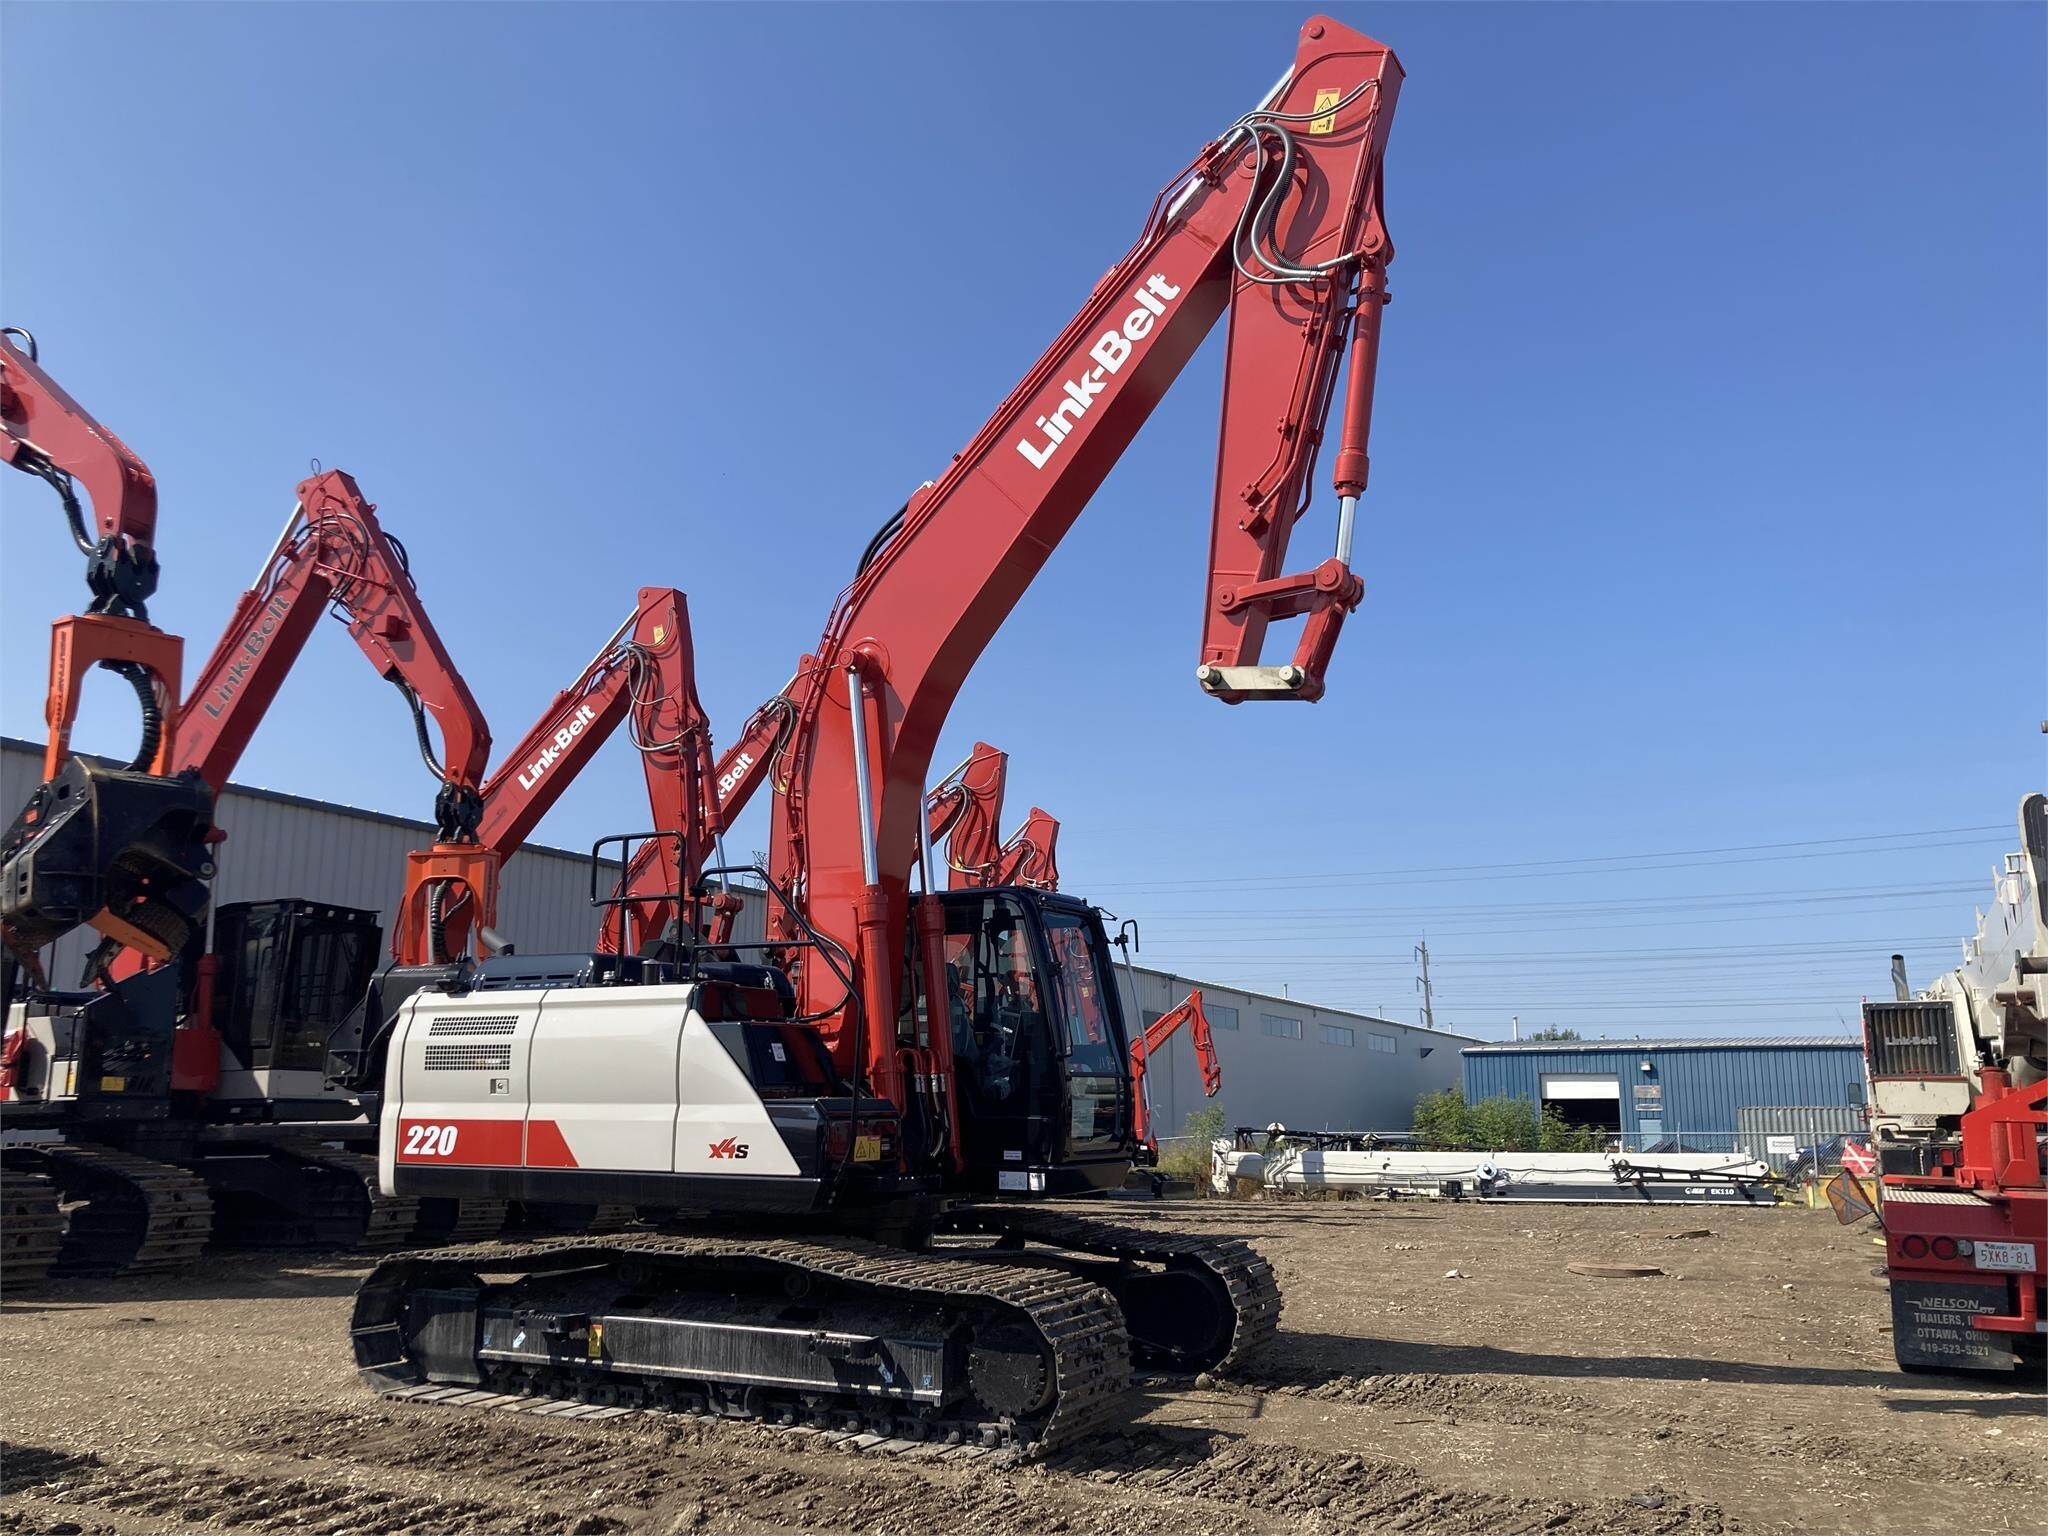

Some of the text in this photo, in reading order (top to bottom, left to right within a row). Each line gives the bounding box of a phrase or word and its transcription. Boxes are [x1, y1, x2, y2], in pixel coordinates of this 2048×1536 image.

[1016, 273, 1181, 470] Link-Belt
[203, 596, 290, 720] Link-Belt
[517, 704, 596, 791] Link-Belt
[403, 1125, 458, 1156] 220
[1981, 1249, 2030, 1265] 5XK8-81
[1922, 1297, 1979, 1310] NELSON
[1914, 1312, 1965, 1327] TRAILERS,
[1917, 1327, 1991, 1342] OTTAWA, OHIO
